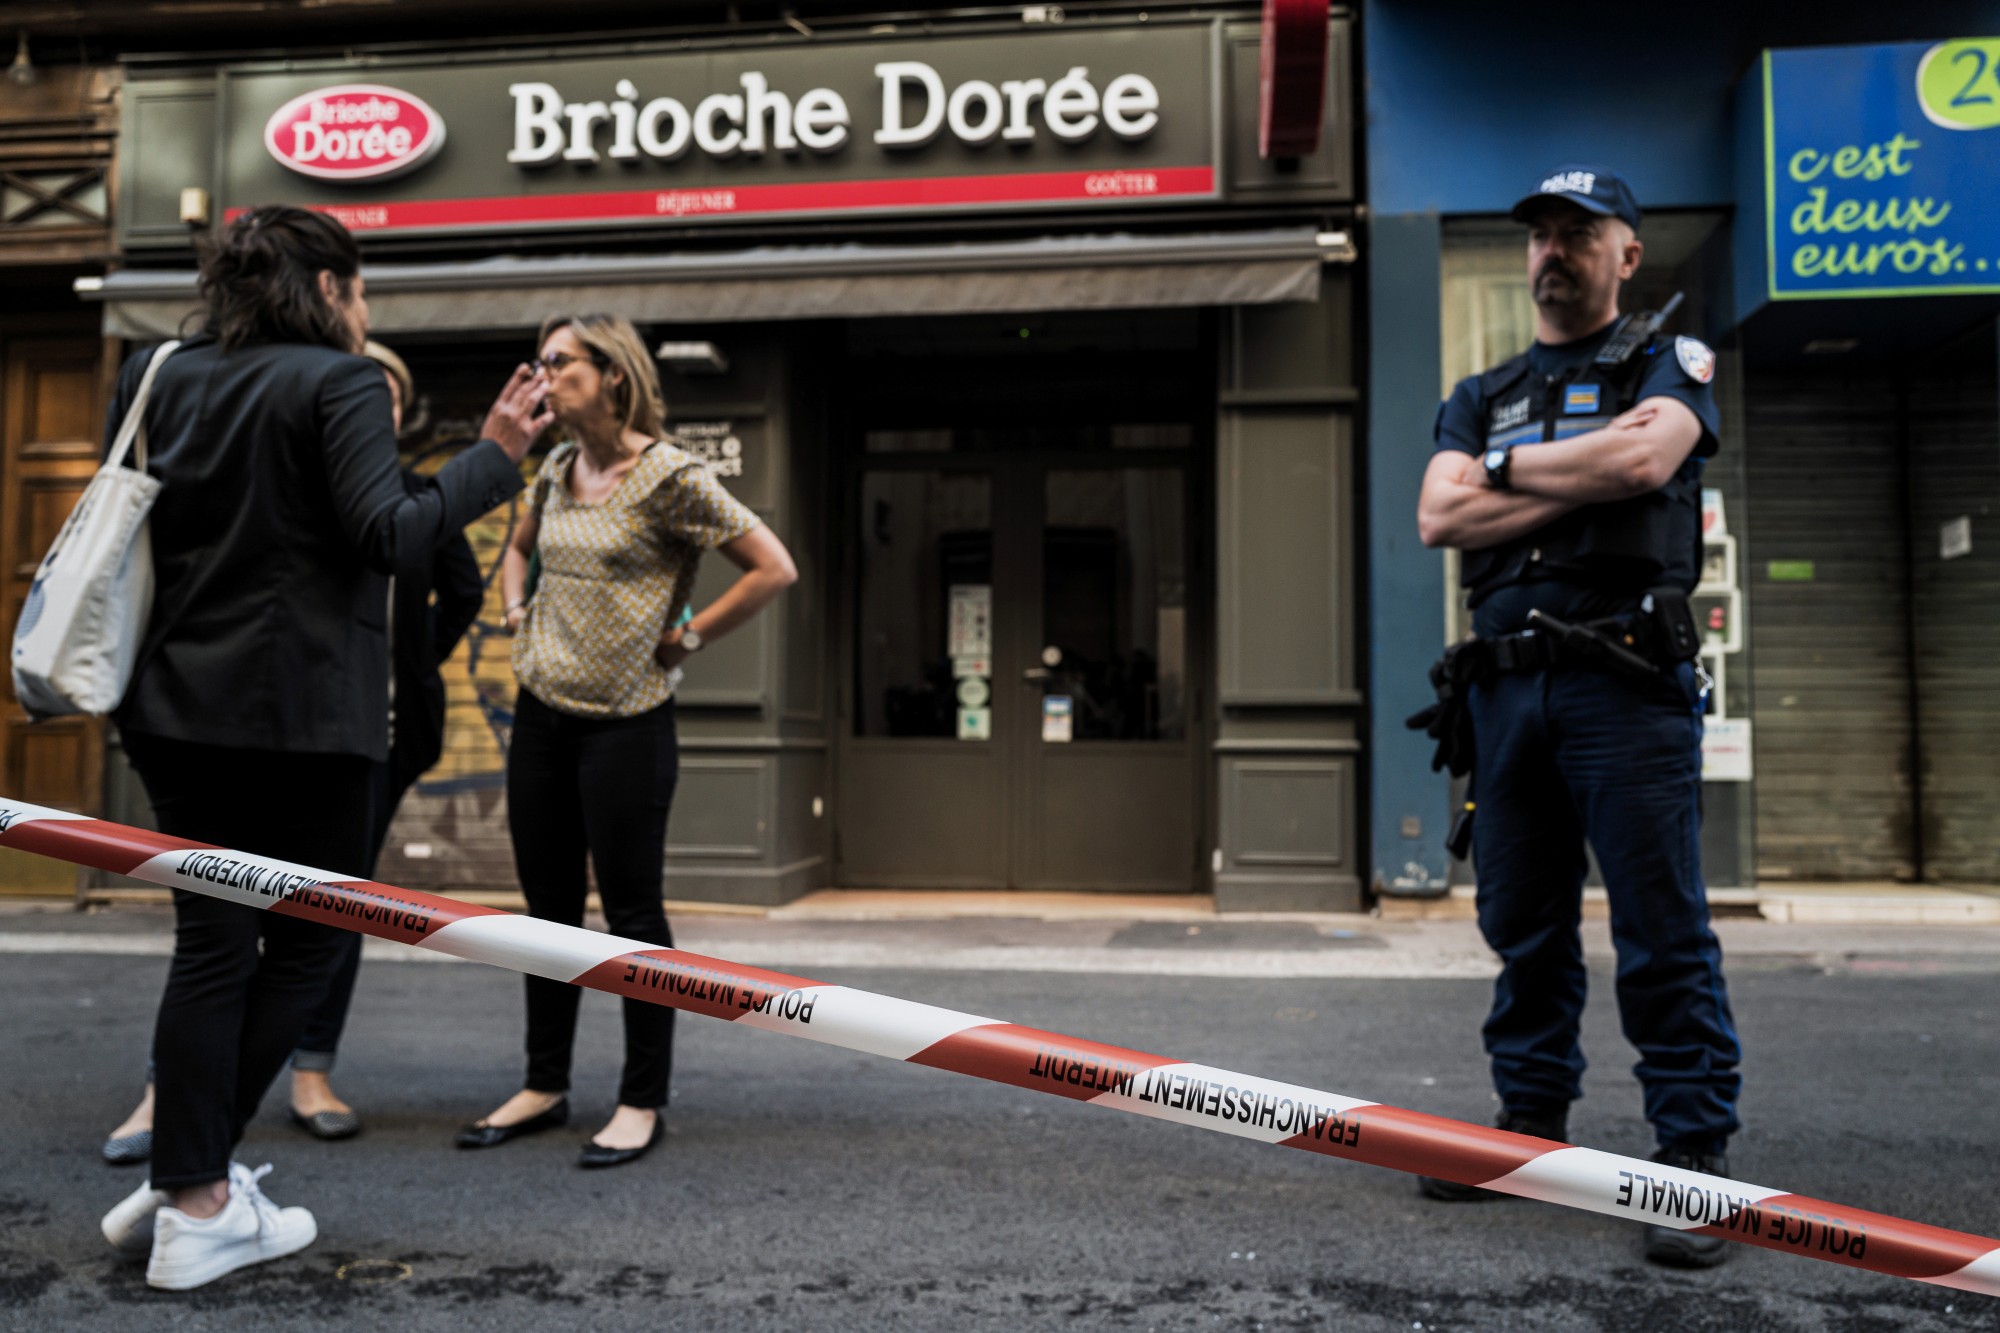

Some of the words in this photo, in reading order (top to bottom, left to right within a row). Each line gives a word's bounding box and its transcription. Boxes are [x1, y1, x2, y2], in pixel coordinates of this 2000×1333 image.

[1949, 48, 2000, 107] 2
[310, 97, 399, 124] Brioche
[507, 71, 851, 164] Brioche
[874, 61, 1160, 147] Dorée
[292, 122, 413, 162] Dorée
[1790, 186, 1951, 234] deux
[1792, 237, 2000, 278] euros..
[176, 851, 268, 892] INTERDIT
[260, 870, 438, 934] FRANCHISSEMENT
[624, 953, 741, 1006] NATIONALE
[739, 979, 818, 1024] POLICE
[1029, 1044, 1137, 1097] INTERDIT
[1139, 1069, 1361, 1148] FRANCHISSEMENT
[1616, 1170, 1762, 1236] NATIONALE
[1768, 1204, 1867, 1260] POLICE
